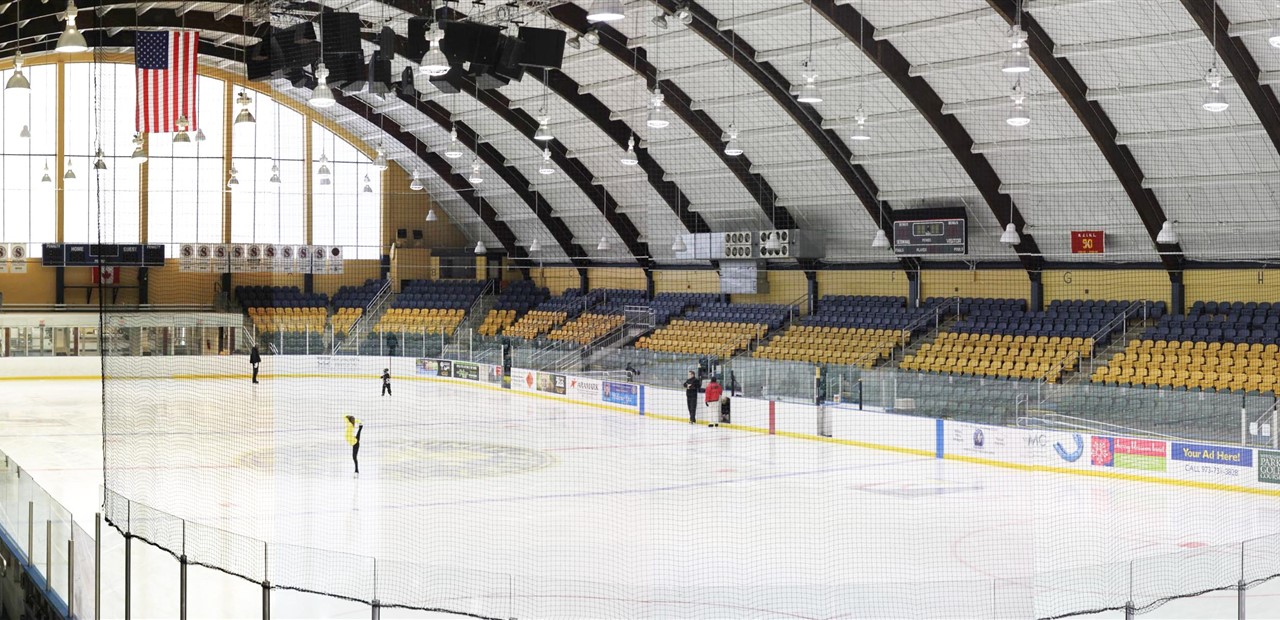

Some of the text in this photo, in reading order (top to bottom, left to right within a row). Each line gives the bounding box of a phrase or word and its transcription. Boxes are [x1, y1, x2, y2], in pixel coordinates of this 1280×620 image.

[1063, 272, 1072, 283] G
[1258, 271, 1264, 284] H
[1183, 448, 1240, 462] Your Ad Here!
[1185, 464, 1200, 473] CALL
